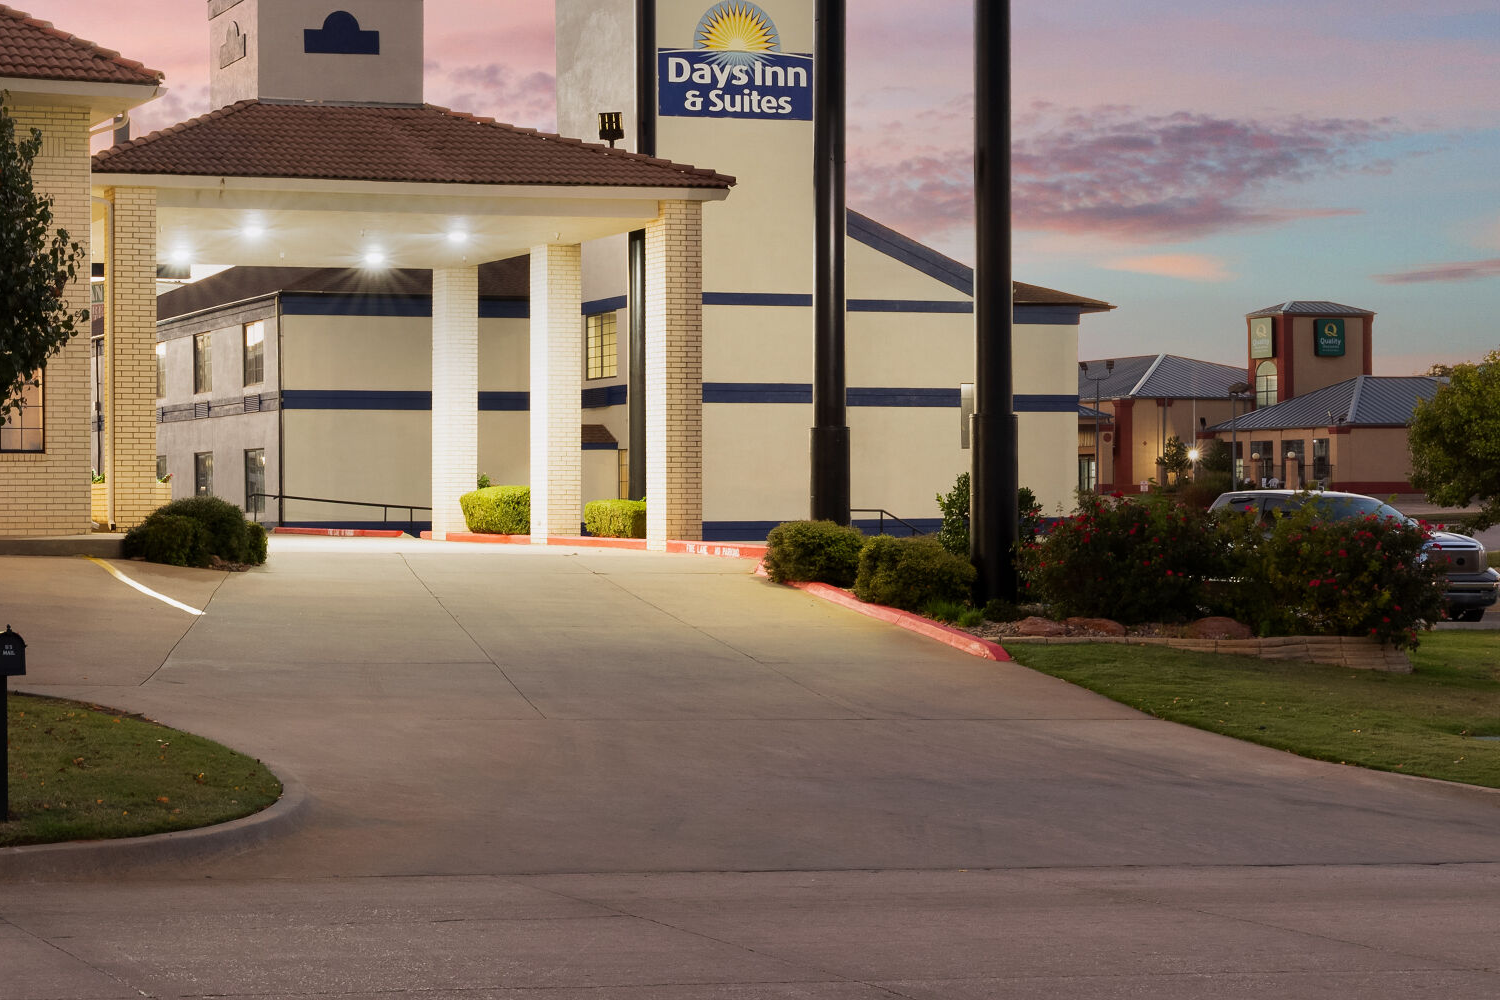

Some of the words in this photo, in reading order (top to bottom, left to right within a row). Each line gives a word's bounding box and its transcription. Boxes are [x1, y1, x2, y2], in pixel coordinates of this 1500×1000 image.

[668, 57, 748, 88] Days
[754, 60, 807, 87] Inn
[684, 90, 703, 111] &
[708, 88, 792, 114] Suites
[1320, 337, 1342, 346] Quality
